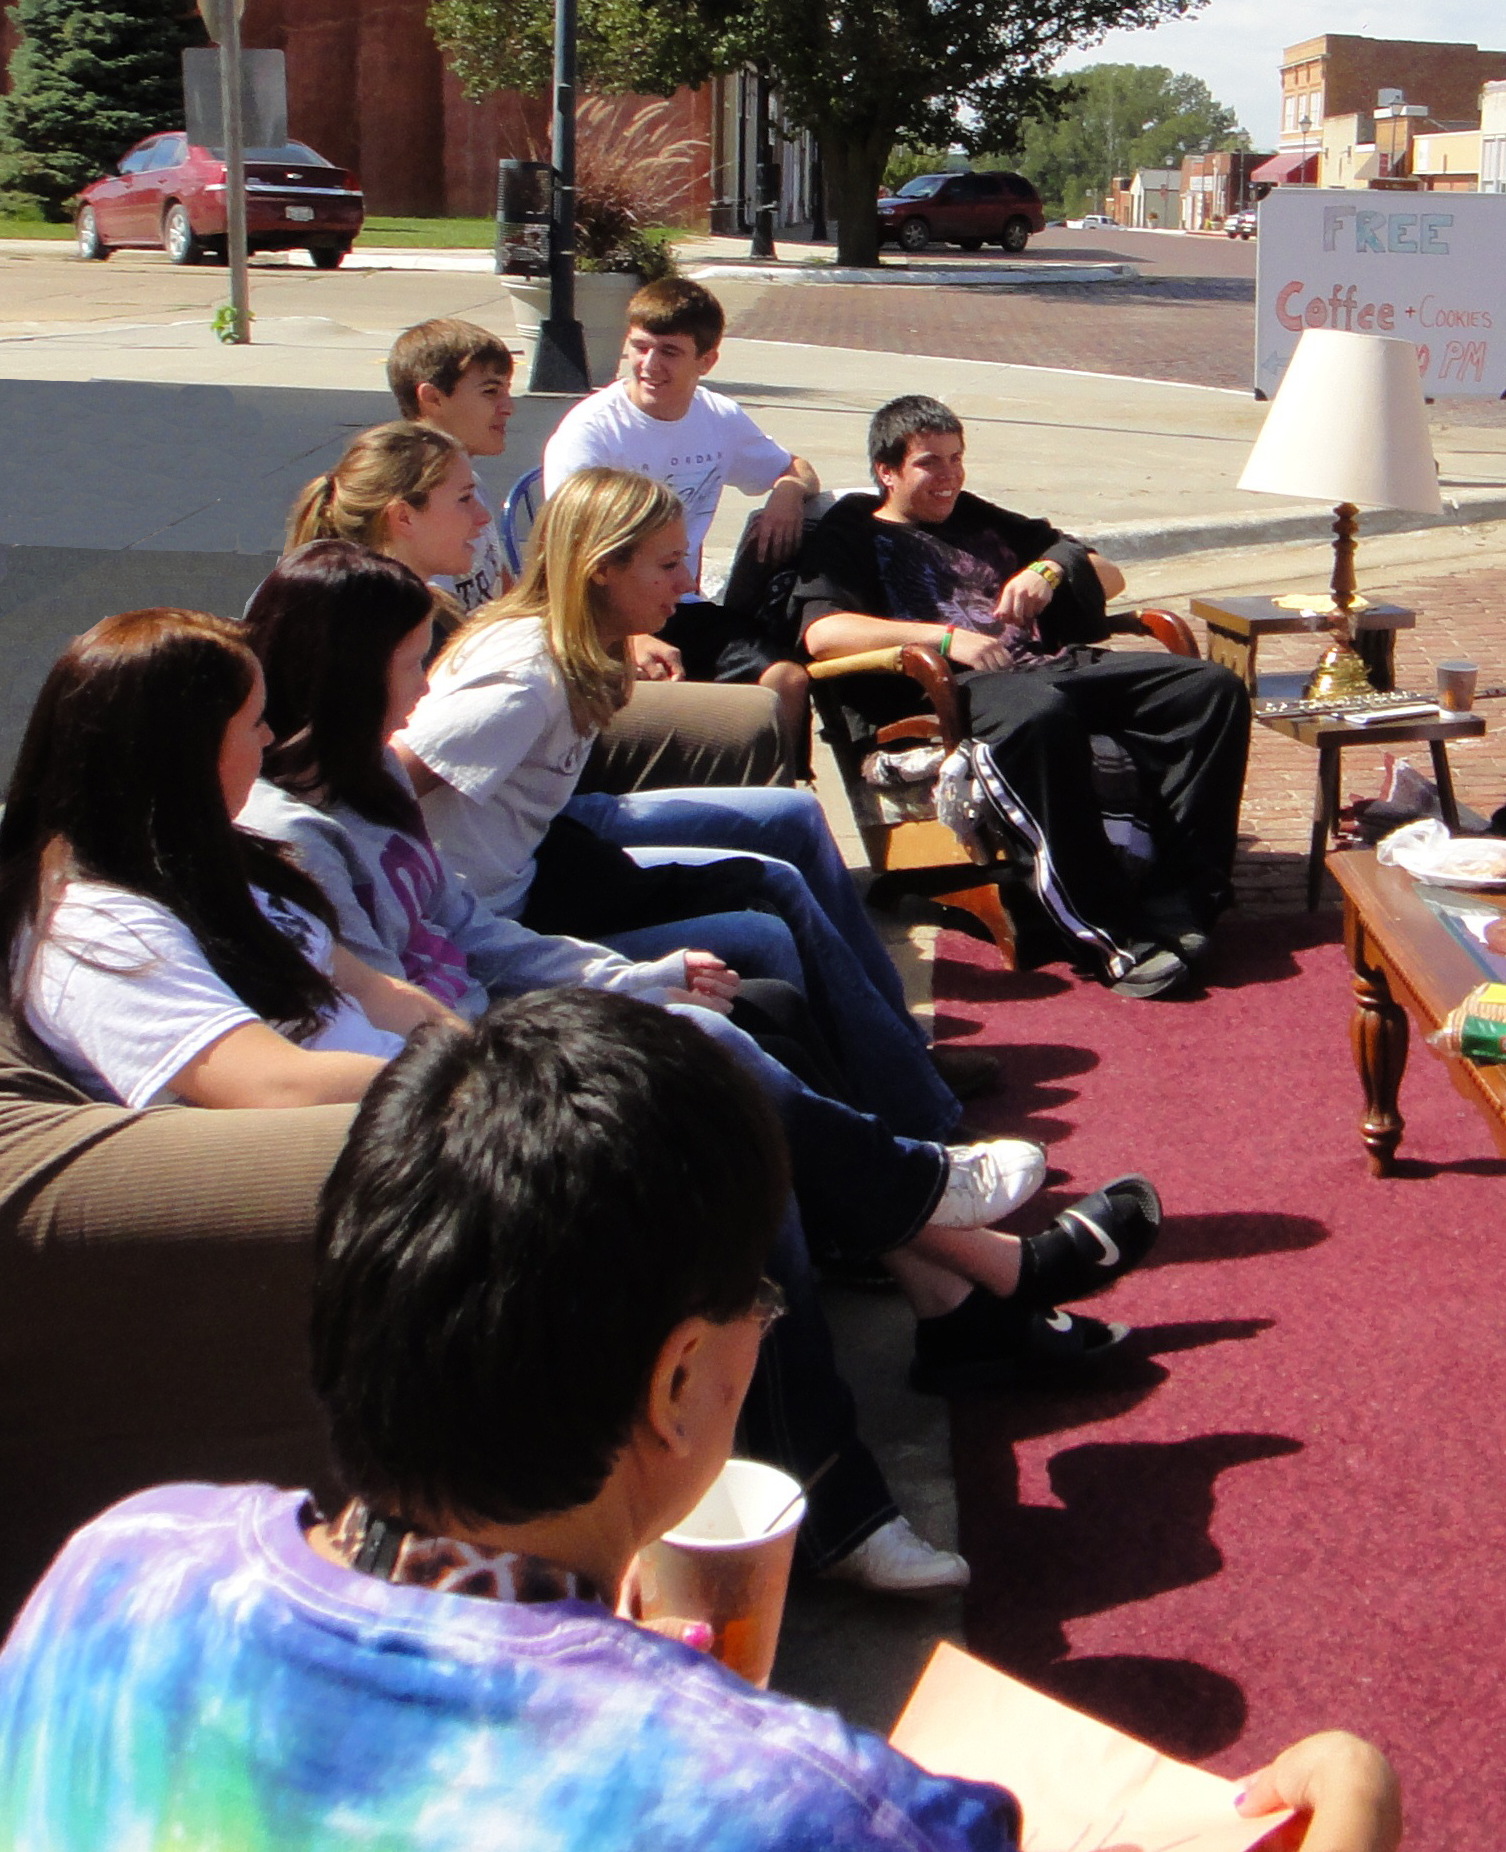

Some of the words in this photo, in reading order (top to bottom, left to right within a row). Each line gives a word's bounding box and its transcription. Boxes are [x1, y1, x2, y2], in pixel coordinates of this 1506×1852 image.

[1323, 205, 1454, 255] FREE
[1275, 280, 1395, 332] Coffee
[1438, 340, 1488, 382] PM
